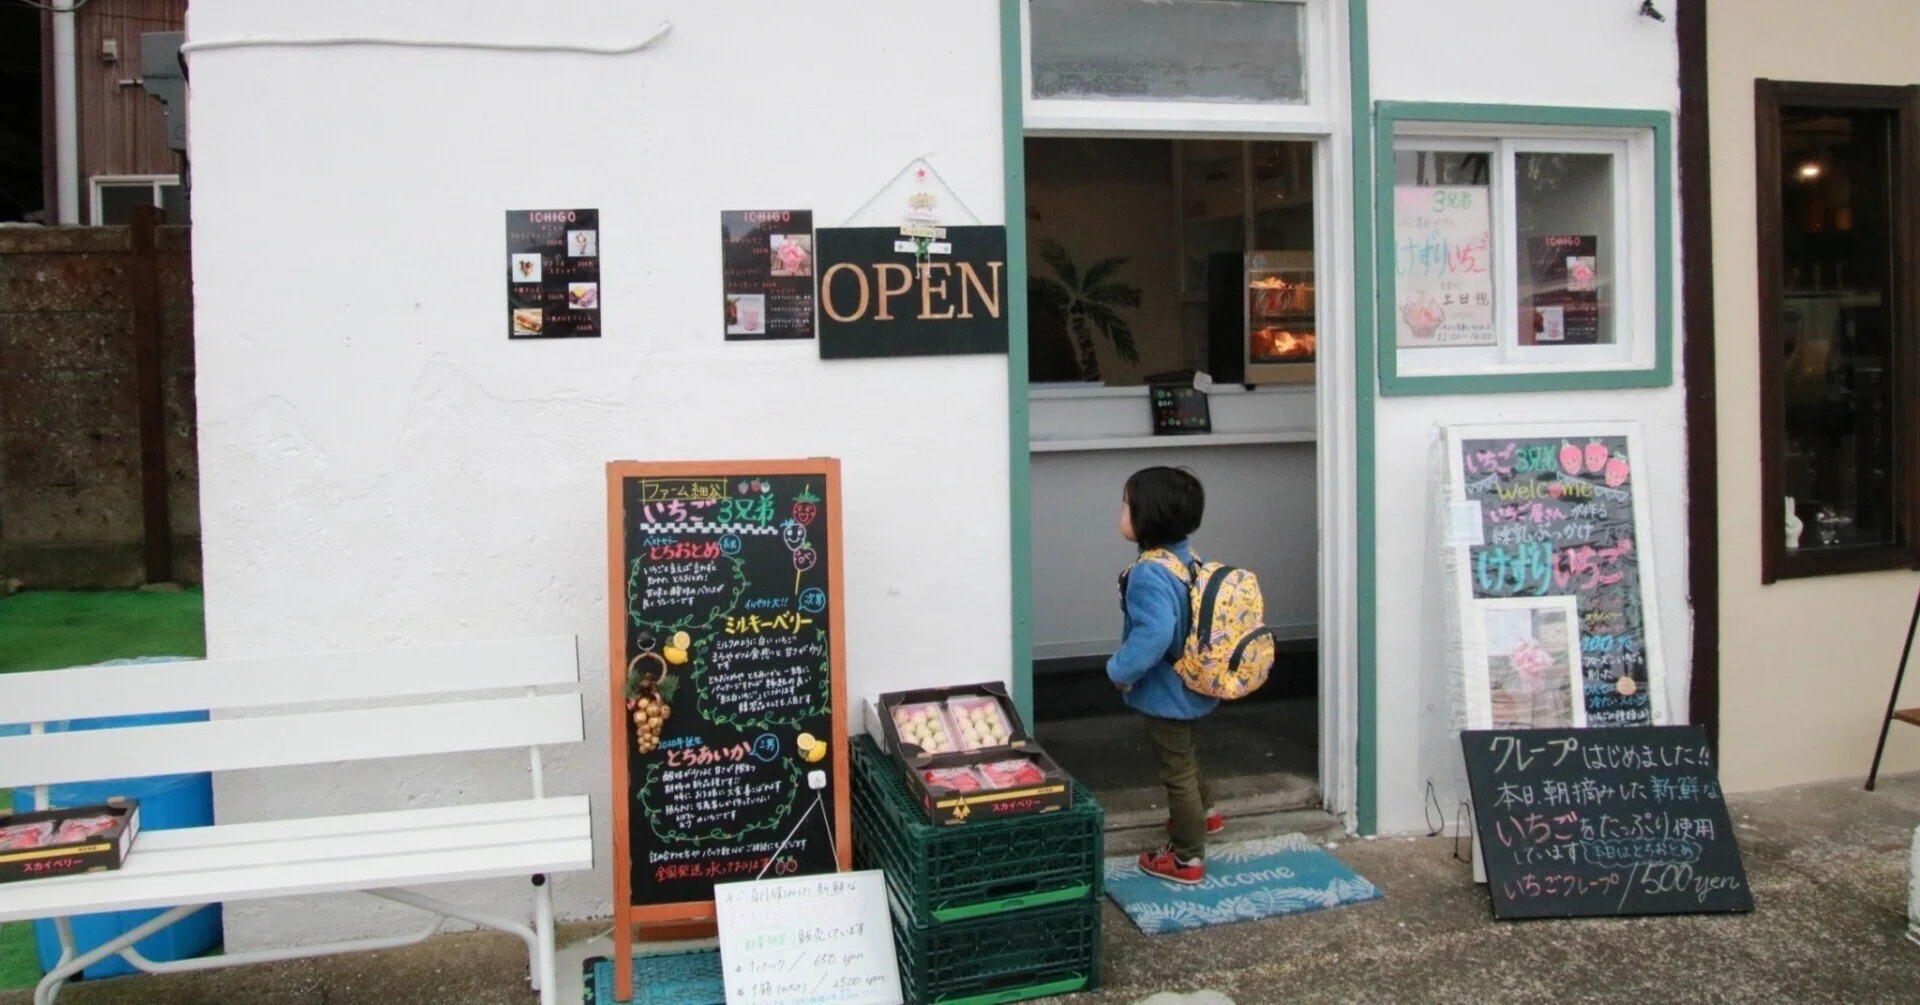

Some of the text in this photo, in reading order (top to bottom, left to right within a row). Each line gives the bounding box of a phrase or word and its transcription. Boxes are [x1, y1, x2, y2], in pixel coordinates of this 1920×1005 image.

[530, 211, 577, 223] ICHIGO
[743, 211, 791, 223] ICHIGO
[821, 260, 1003, 323] OPEN
[644, 481, 723, 500] ファーム細谷
[650, 541, 720, 561] とちおとめ
[1477, 539, 1633, 596] けずりいちご
[725, 610, 813, 635] ミルキーベリー
[667, 741, 751, 768] とちあいか
[992, 800, 1042, 814] スカイベリー
[23, 858, 83, 873] スカイベリー
